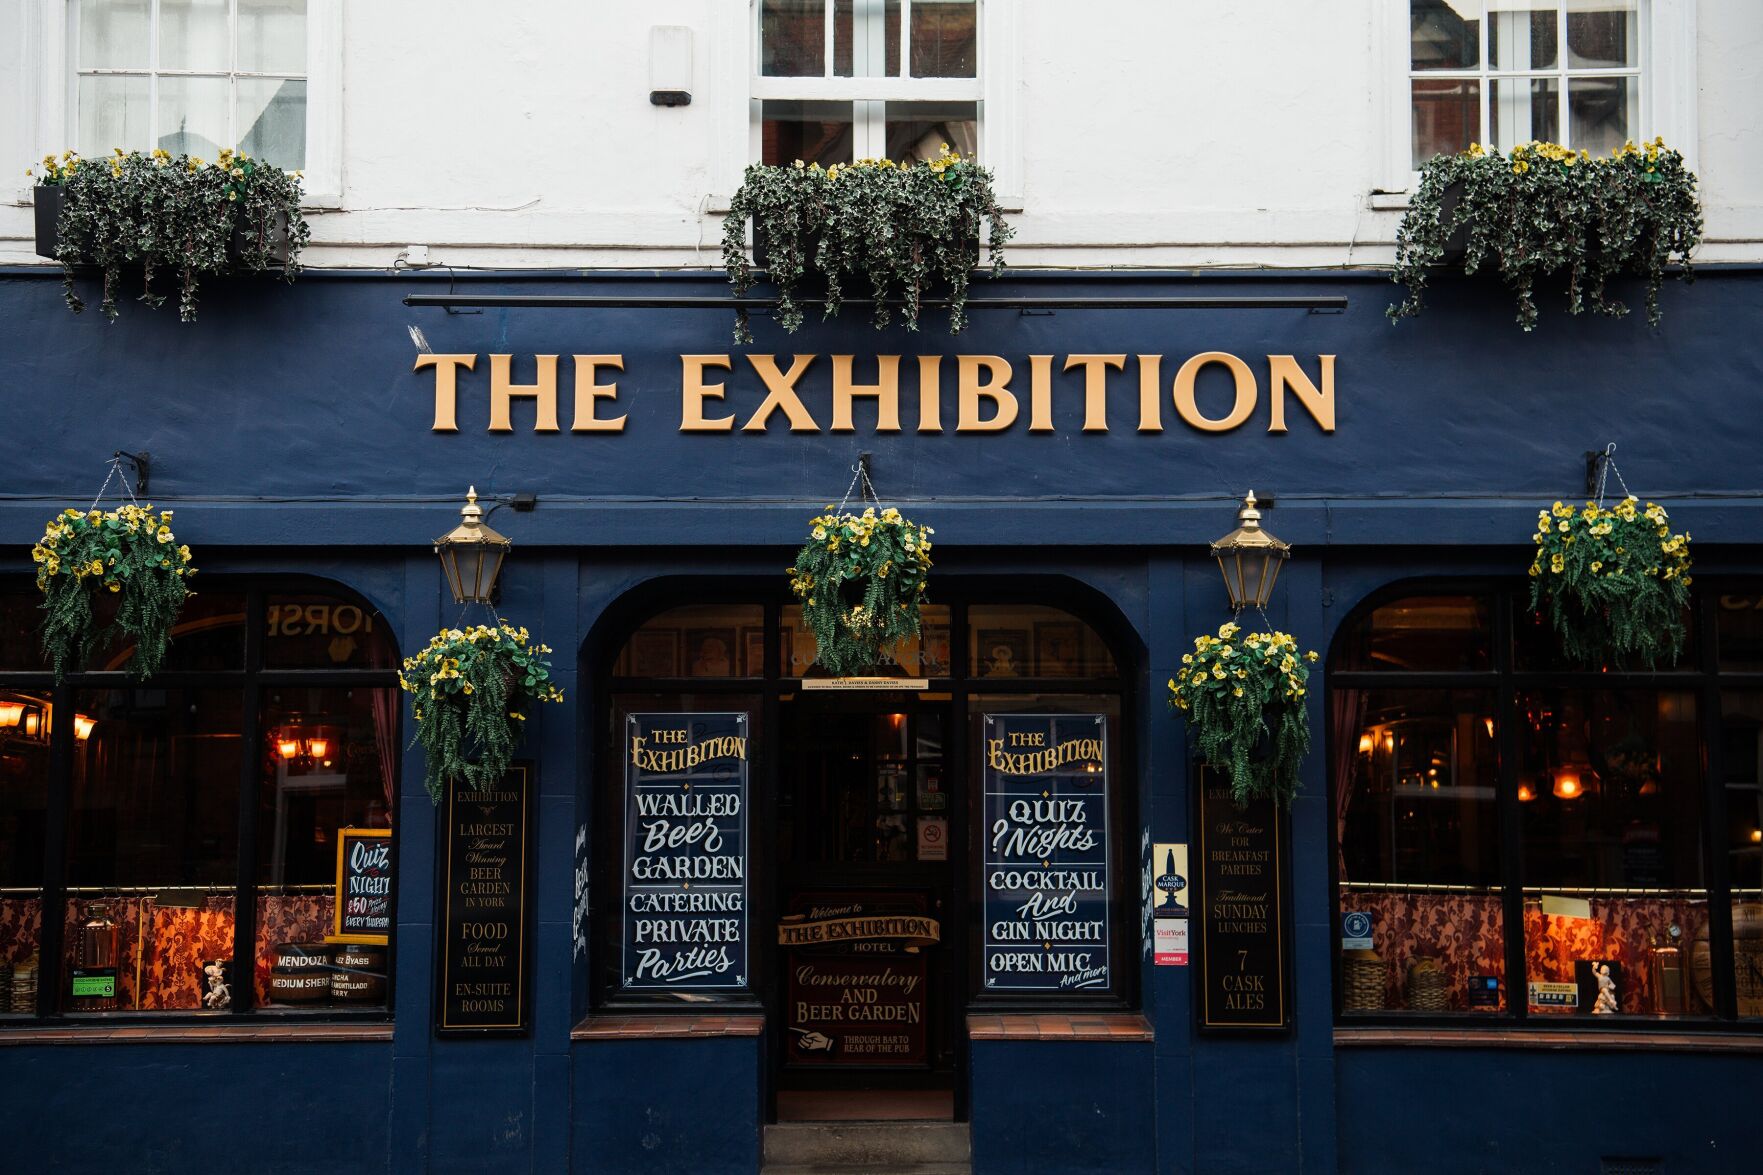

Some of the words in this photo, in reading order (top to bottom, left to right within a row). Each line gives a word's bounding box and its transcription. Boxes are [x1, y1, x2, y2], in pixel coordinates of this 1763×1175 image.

[413, 353, 628, 431] THE
[679, 351, 1337, 432] EXHIBITION
[651, 729, 688, 744] THE
[1008, 733, 1045, 747] THE
[631, 736, 747, 772] EXHIBITION
[988, 738, 1103, 775] EXHIBITION
[635, 794, 741, 817] WALLED
[1008, 800, 1087, 824] QUIZ
[460, 823, 514, 836] LARGEST
[642, 817, 723, 853] Beer
[468, 838, 504, 850] Award
[1004, 822, 1098, 859] Nights
[1231, 836, 1249, 847] FOR
[350, 841, 390, 873] Quiz
[465, 851, 507, 866] Winning
[1212, 850, 1270, 862] BREAKFAST
[469, 867, 502, 880] BEER
[631, 856, 743, 880] GARDEN
[1220, 864, 1262, 875] PARTIES
[349, 876, 391, 894] NIGHT
[460, 882, 511, 895] GARDEN
[989, 871, 1104, 891] COCKTAIL
[465, 897, 476, 907] IN
[478, 897, 505, 907] YORK
[629, 893, 743, 913] CATERING
[1216, 890, 1267, 901] Traditional
[809, 905, 851, 919] Welcome
[852, 903, 863, 912] to
[1016, 890, 1077, 919] And
[1214, 904, 1269, 919] SUNDAY
[346, 915, 365, 927] EVERY
[1218, 922, 1267, 933] LUNCHES
[461, 922, 508, 940] FOOD
[634, 919, 740, 943] PRIVATE
[784, 924, 823, 943] THE
[827, 918, 931, 938] EXHIBITION
[991, 921, 1030, 941] GIN
[1035, 921, 1104, 941] NIGHT
[467, 941, 501, 954] Served
[853, 942, 896, 952] HOTEL
[277, 955, 328, 967] MENDOZA
[460, 955, 482, 967] ALL
[484, 955, 507, 967] DAY
[635, 943, 735, 980] Parties
[989, 953, 1043, 973] OPEN
[1047, 953, 1092, 973] MIC
[1238, 950, 1248, 971] 7
[272, 978, 304, 988] MEDIUM
[304, 977, 330, 988] SHERR
[796, 964, 921, 995] Conservatory
[1059, 972, 1082, 988] And
[1222, 974, 1265, 992] CASK
[455, 983, 512, 996] EN-SUITE
[840, 988, 878, 1004] AND
[461, 999, 505, 1013] ROOMS
[1225, 993, 1265, 1010] ALES
[796, 1001, 844, 1023] BEER
[848, 1002, 921, 1024] GARDEN
[844, 1035, 881, 1044] THROUGH
[882, 1035, 898, 1044] BAR
[898, 1035, 909, 1044] TO
[844, 1044, 865, 1053] REAR
[865, 1044, 876, 1053] OF
[877, 1044, 893, 1053] THE
[894, 1044, 910, 1053] PUB
